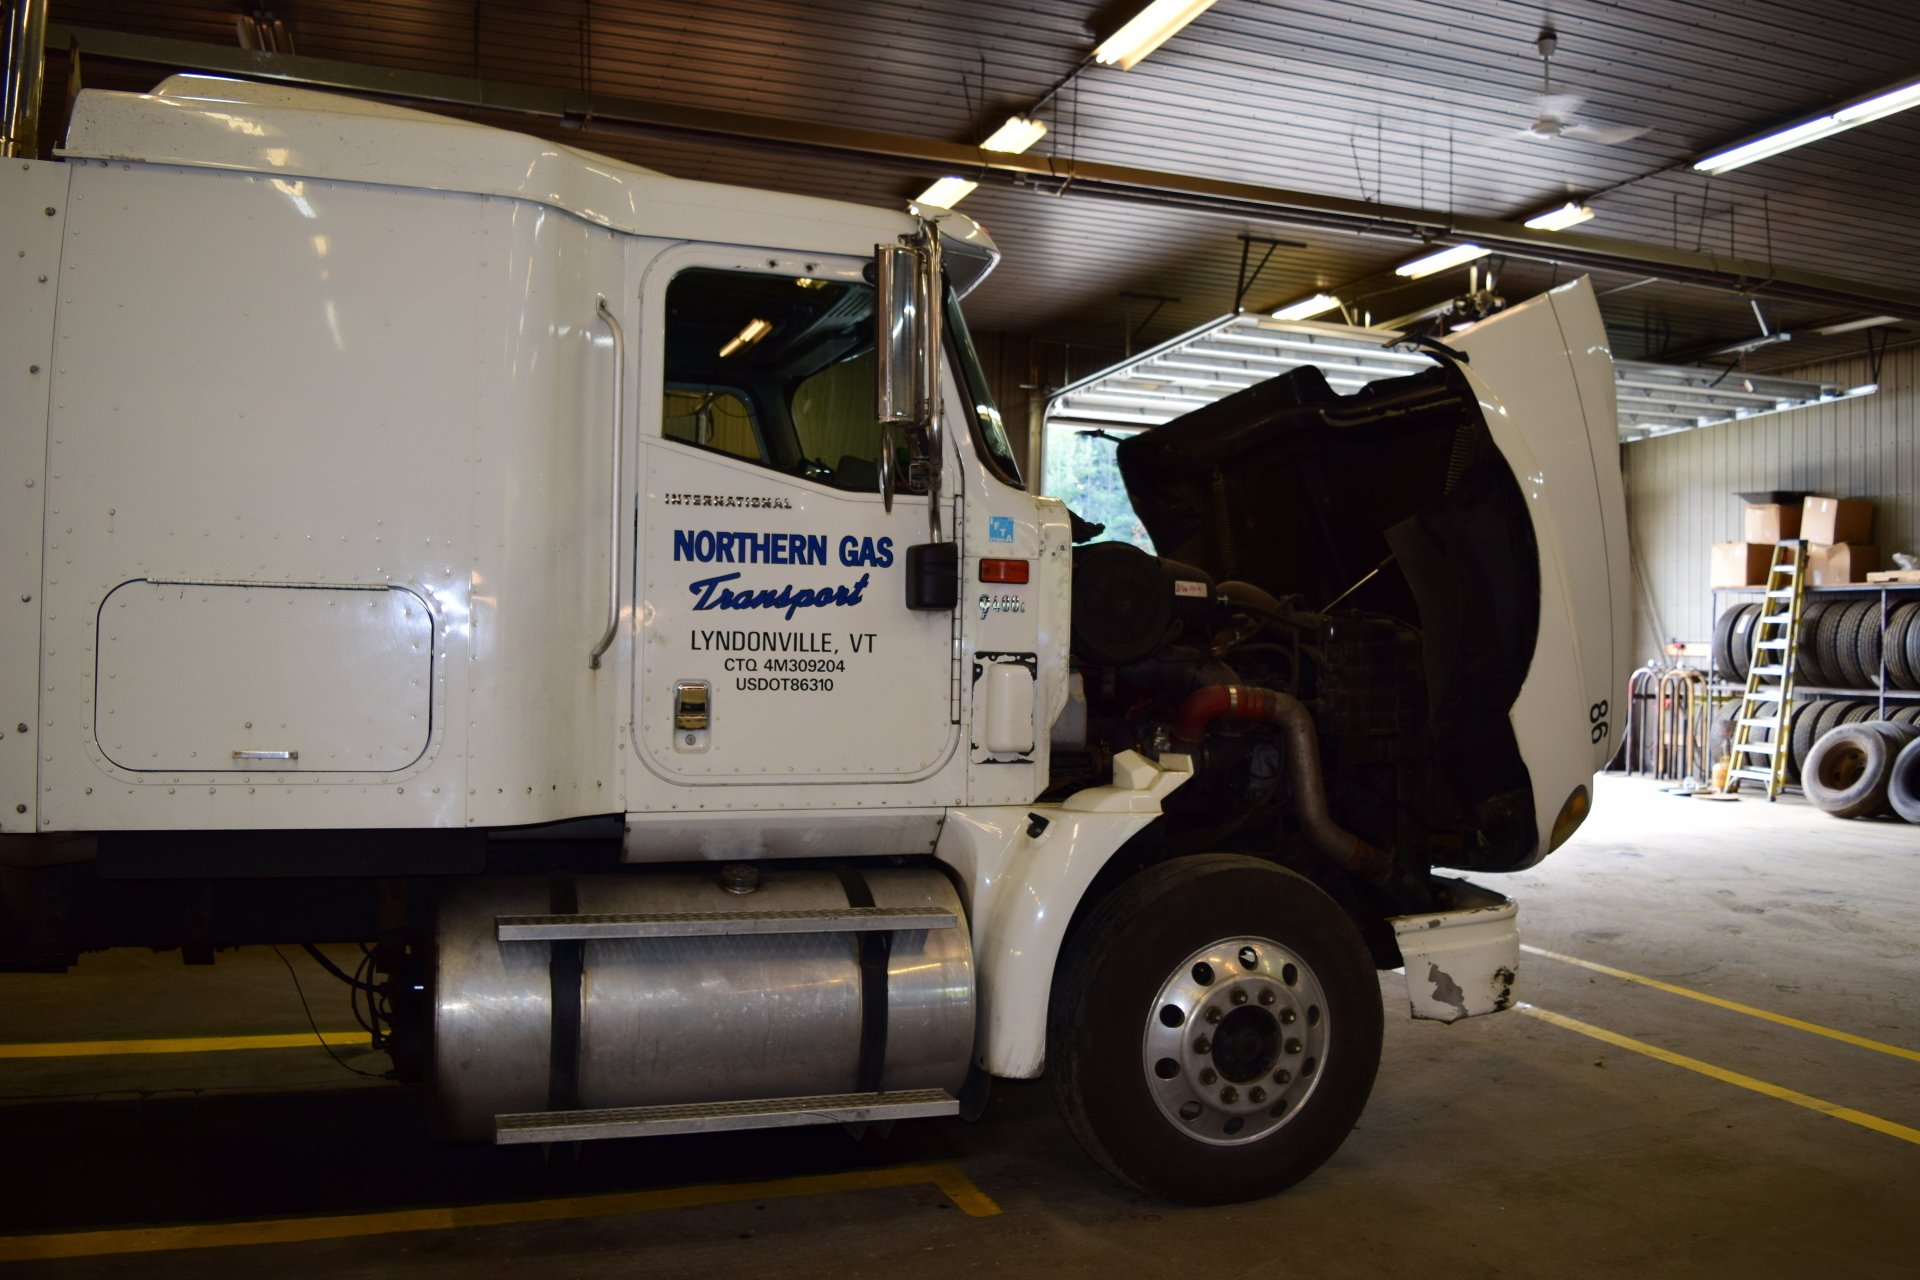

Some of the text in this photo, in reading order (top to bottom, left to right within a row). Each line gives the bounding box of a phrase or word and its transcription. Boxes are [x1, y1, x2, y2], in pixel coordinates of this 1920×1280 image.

[665, 493, 792, 509] INTERNATIONAL
[673, 529, 894, 568] NORTHERN GAS
[689, 572, 870, 621] Transport
[691, 630, 877, 655] LYNDONVILLE, VT
[724, 658, 846, 673] CTQ 4M309204
[736, 677, 834, 692] USDOT86310
[1589, 699, 1609, 744] 86
